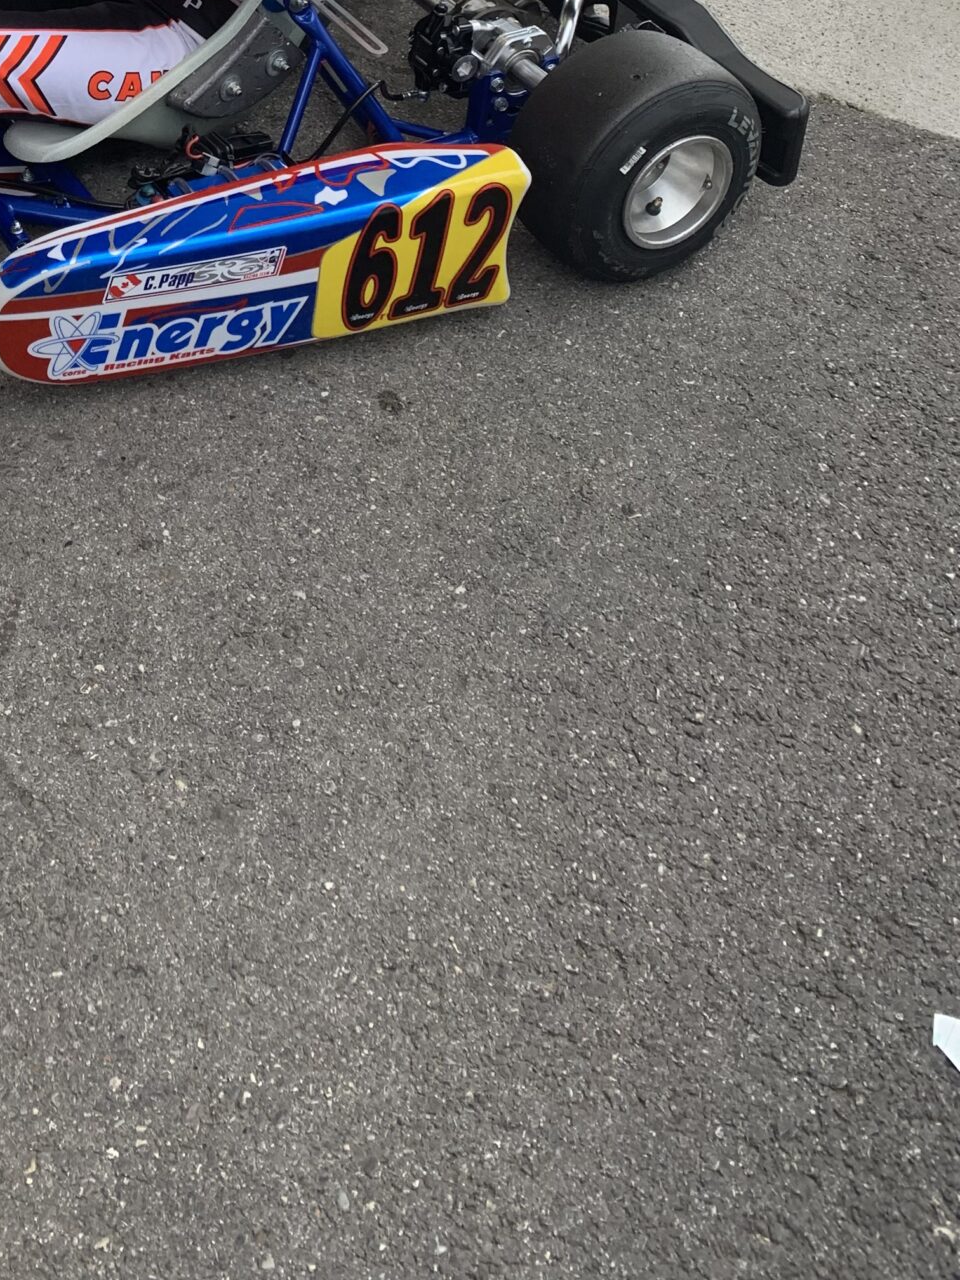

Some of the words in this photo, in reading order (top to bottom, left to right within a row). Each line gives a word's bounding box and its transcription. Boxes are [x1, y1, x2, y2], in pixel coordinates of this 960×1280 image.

[341, 182, 513, 332] 612
[144, 272, 196, 291] C.Papp
[73, 302, 303, 368] Energy
[103, 356, 165, 371] Racing
[169, 347, 216, 361] Karts
